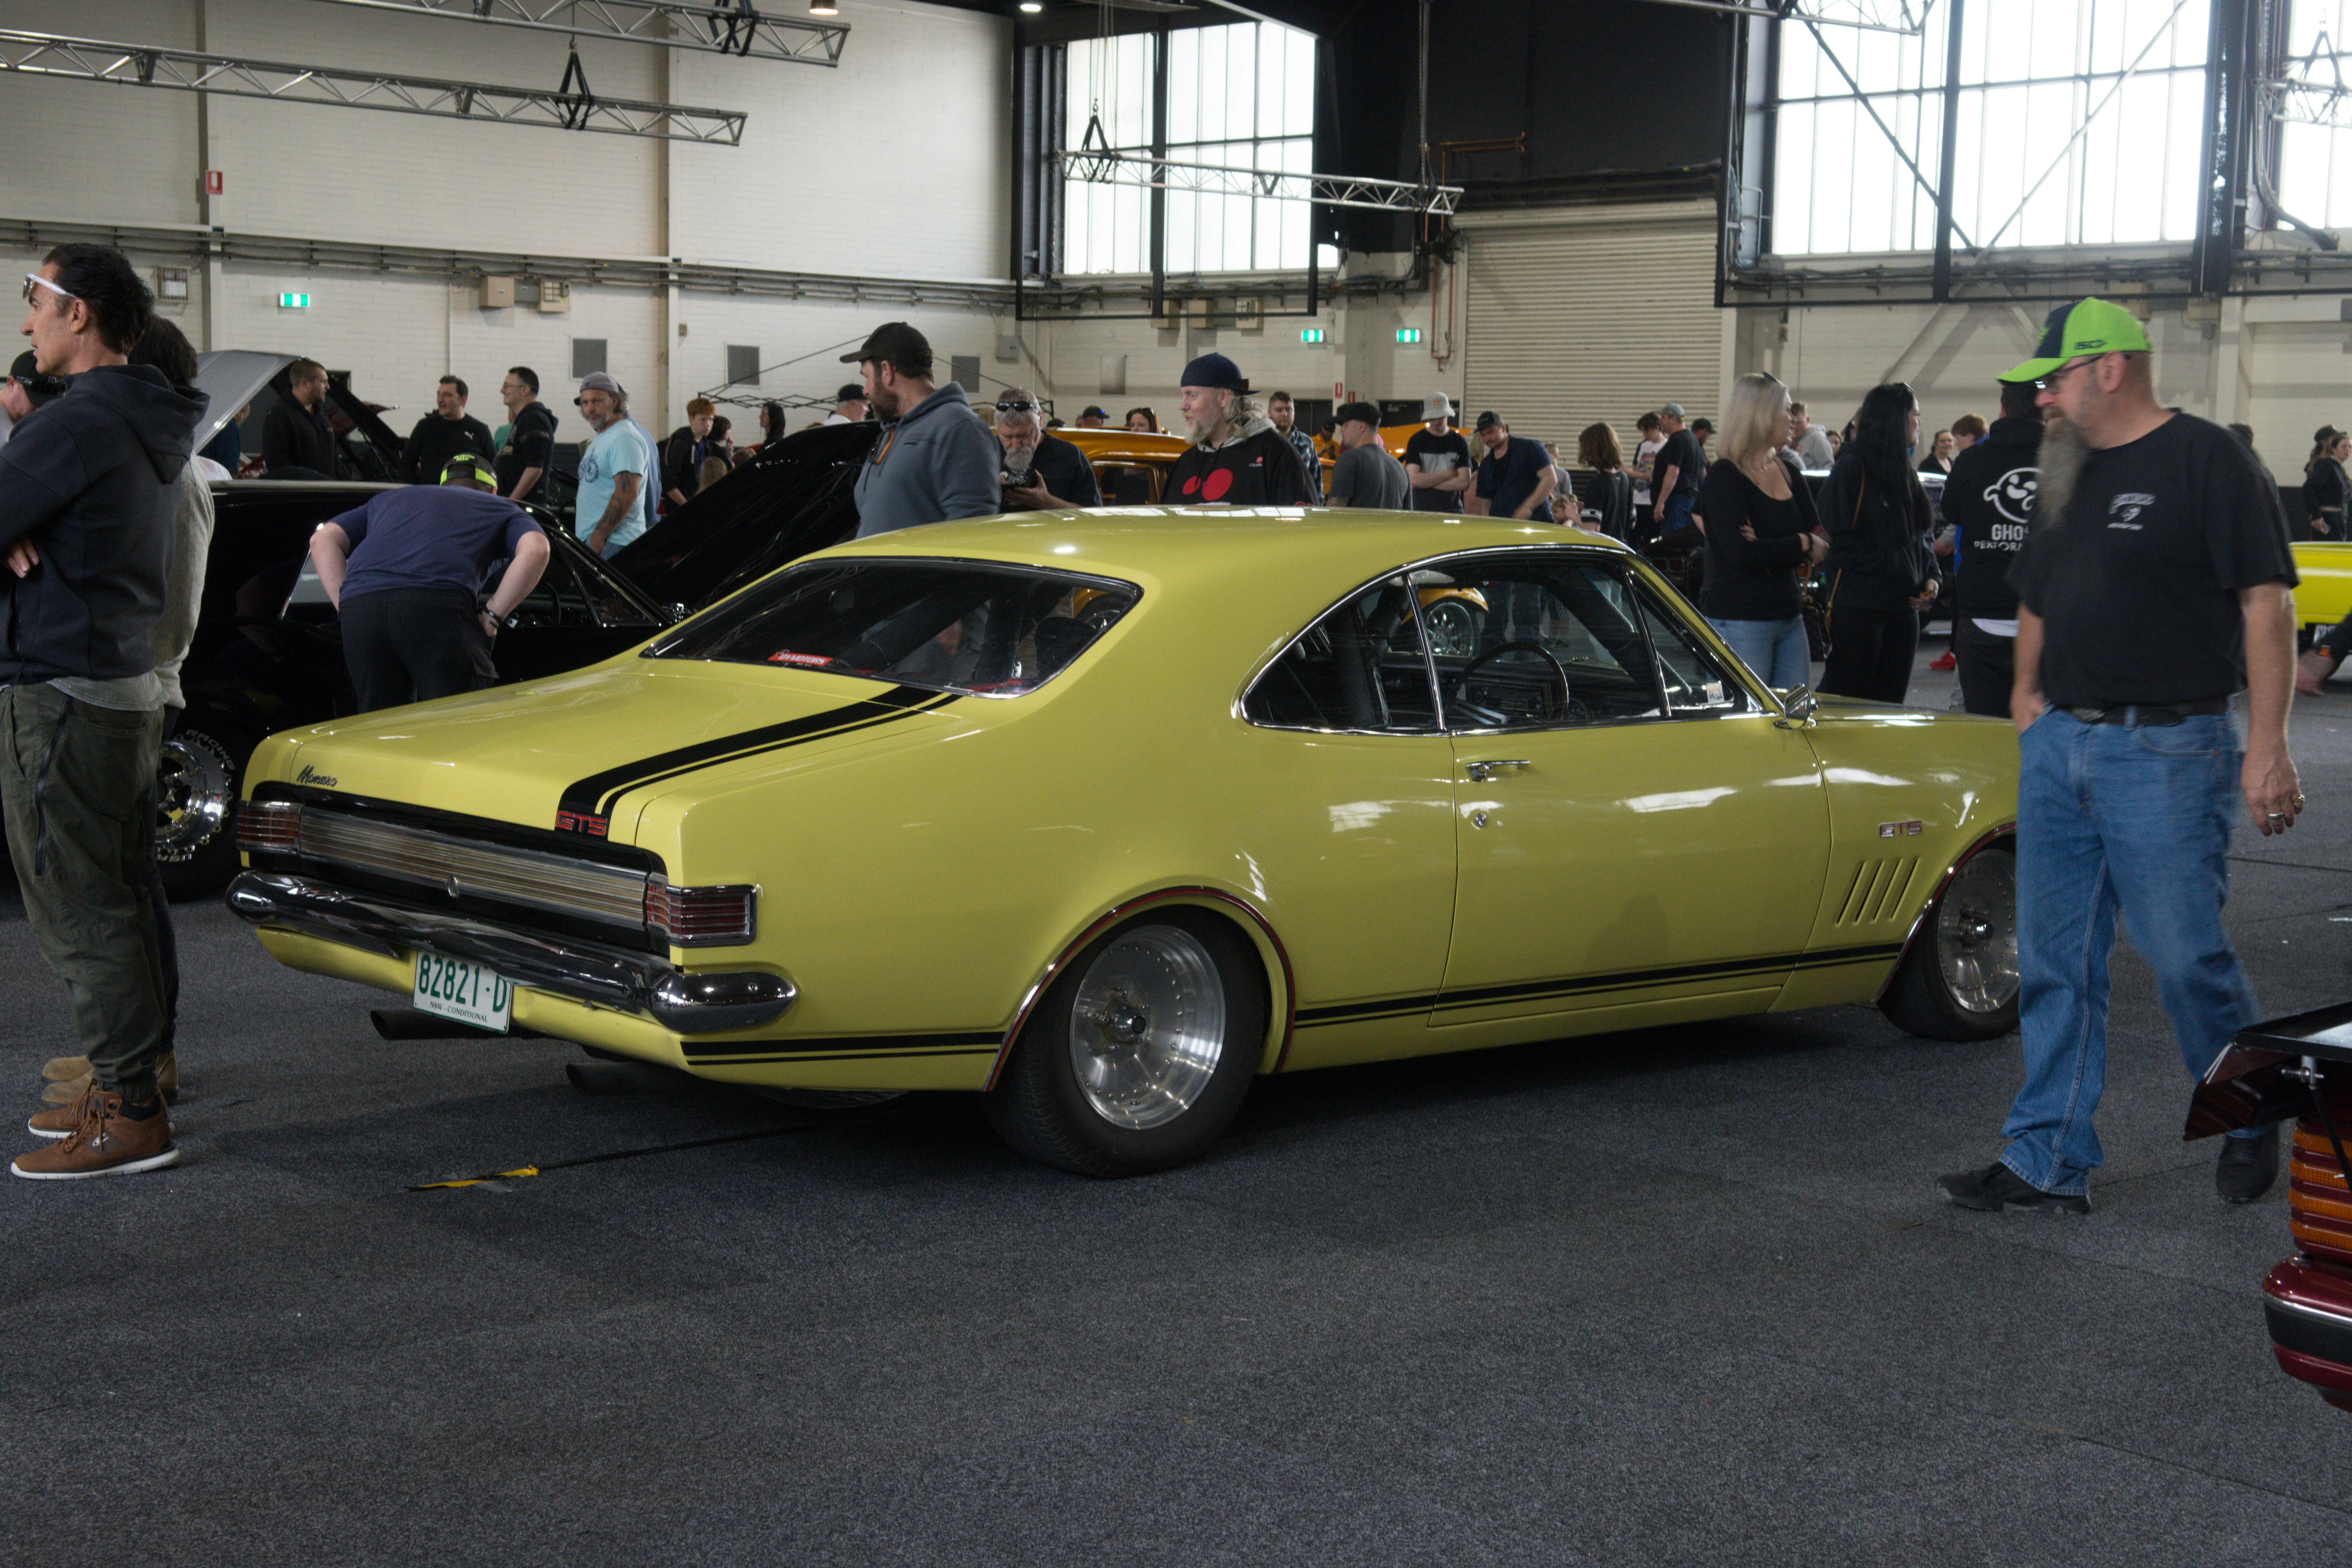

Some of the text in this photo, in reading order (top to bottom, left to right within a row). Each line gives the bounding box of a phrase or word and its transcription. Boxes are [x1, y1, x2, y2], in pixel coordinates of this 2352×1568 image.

[185, 729, 235, 770] RACING
[296, 764, 338, 787] Monaro
[555, 810, 607, 836] GTS
[1879, 820, 1922, 837] GTS
[430, 1002, 443, 1011] NSW
[447, 1006, 488, 1022] CONDITIONAL
